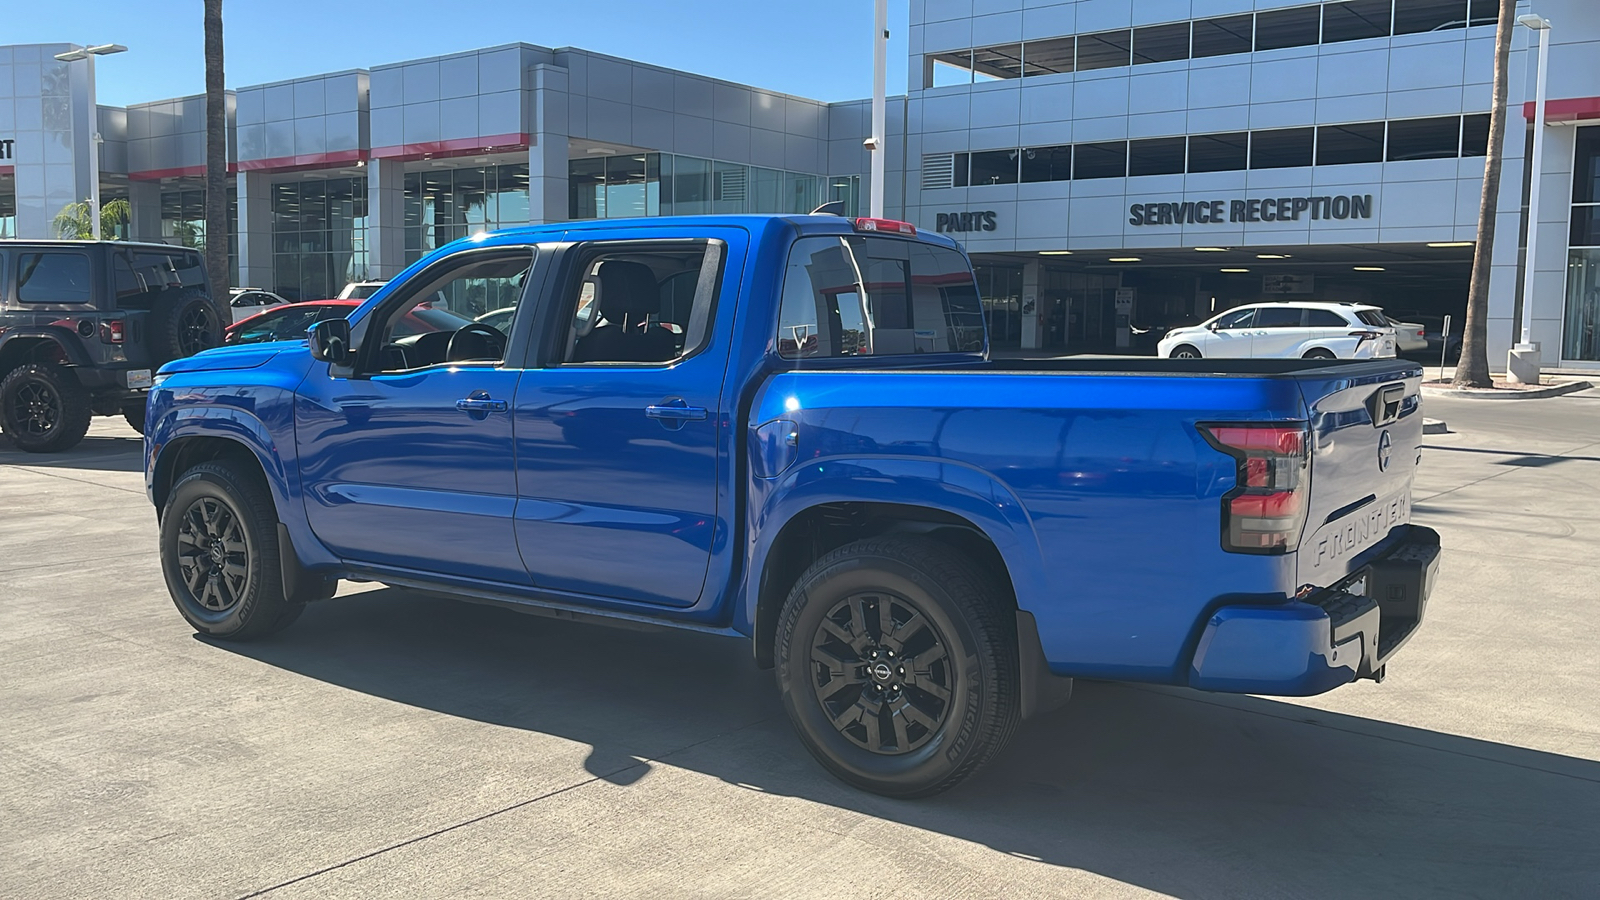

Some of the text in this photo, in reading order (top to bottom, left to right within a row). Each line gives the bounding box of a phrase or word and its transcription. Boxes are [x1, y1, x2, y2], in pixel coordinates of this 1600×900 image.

[936, 211, 997, 232] PARTS
[1129, 194, 1372, 226] SERVICE RECEPTION
[1313, 494, 1406, 568] FRONTIER
[781, 592, 807, 660] MICHELIN
[948, 691, 978, 761] MICHELIN
